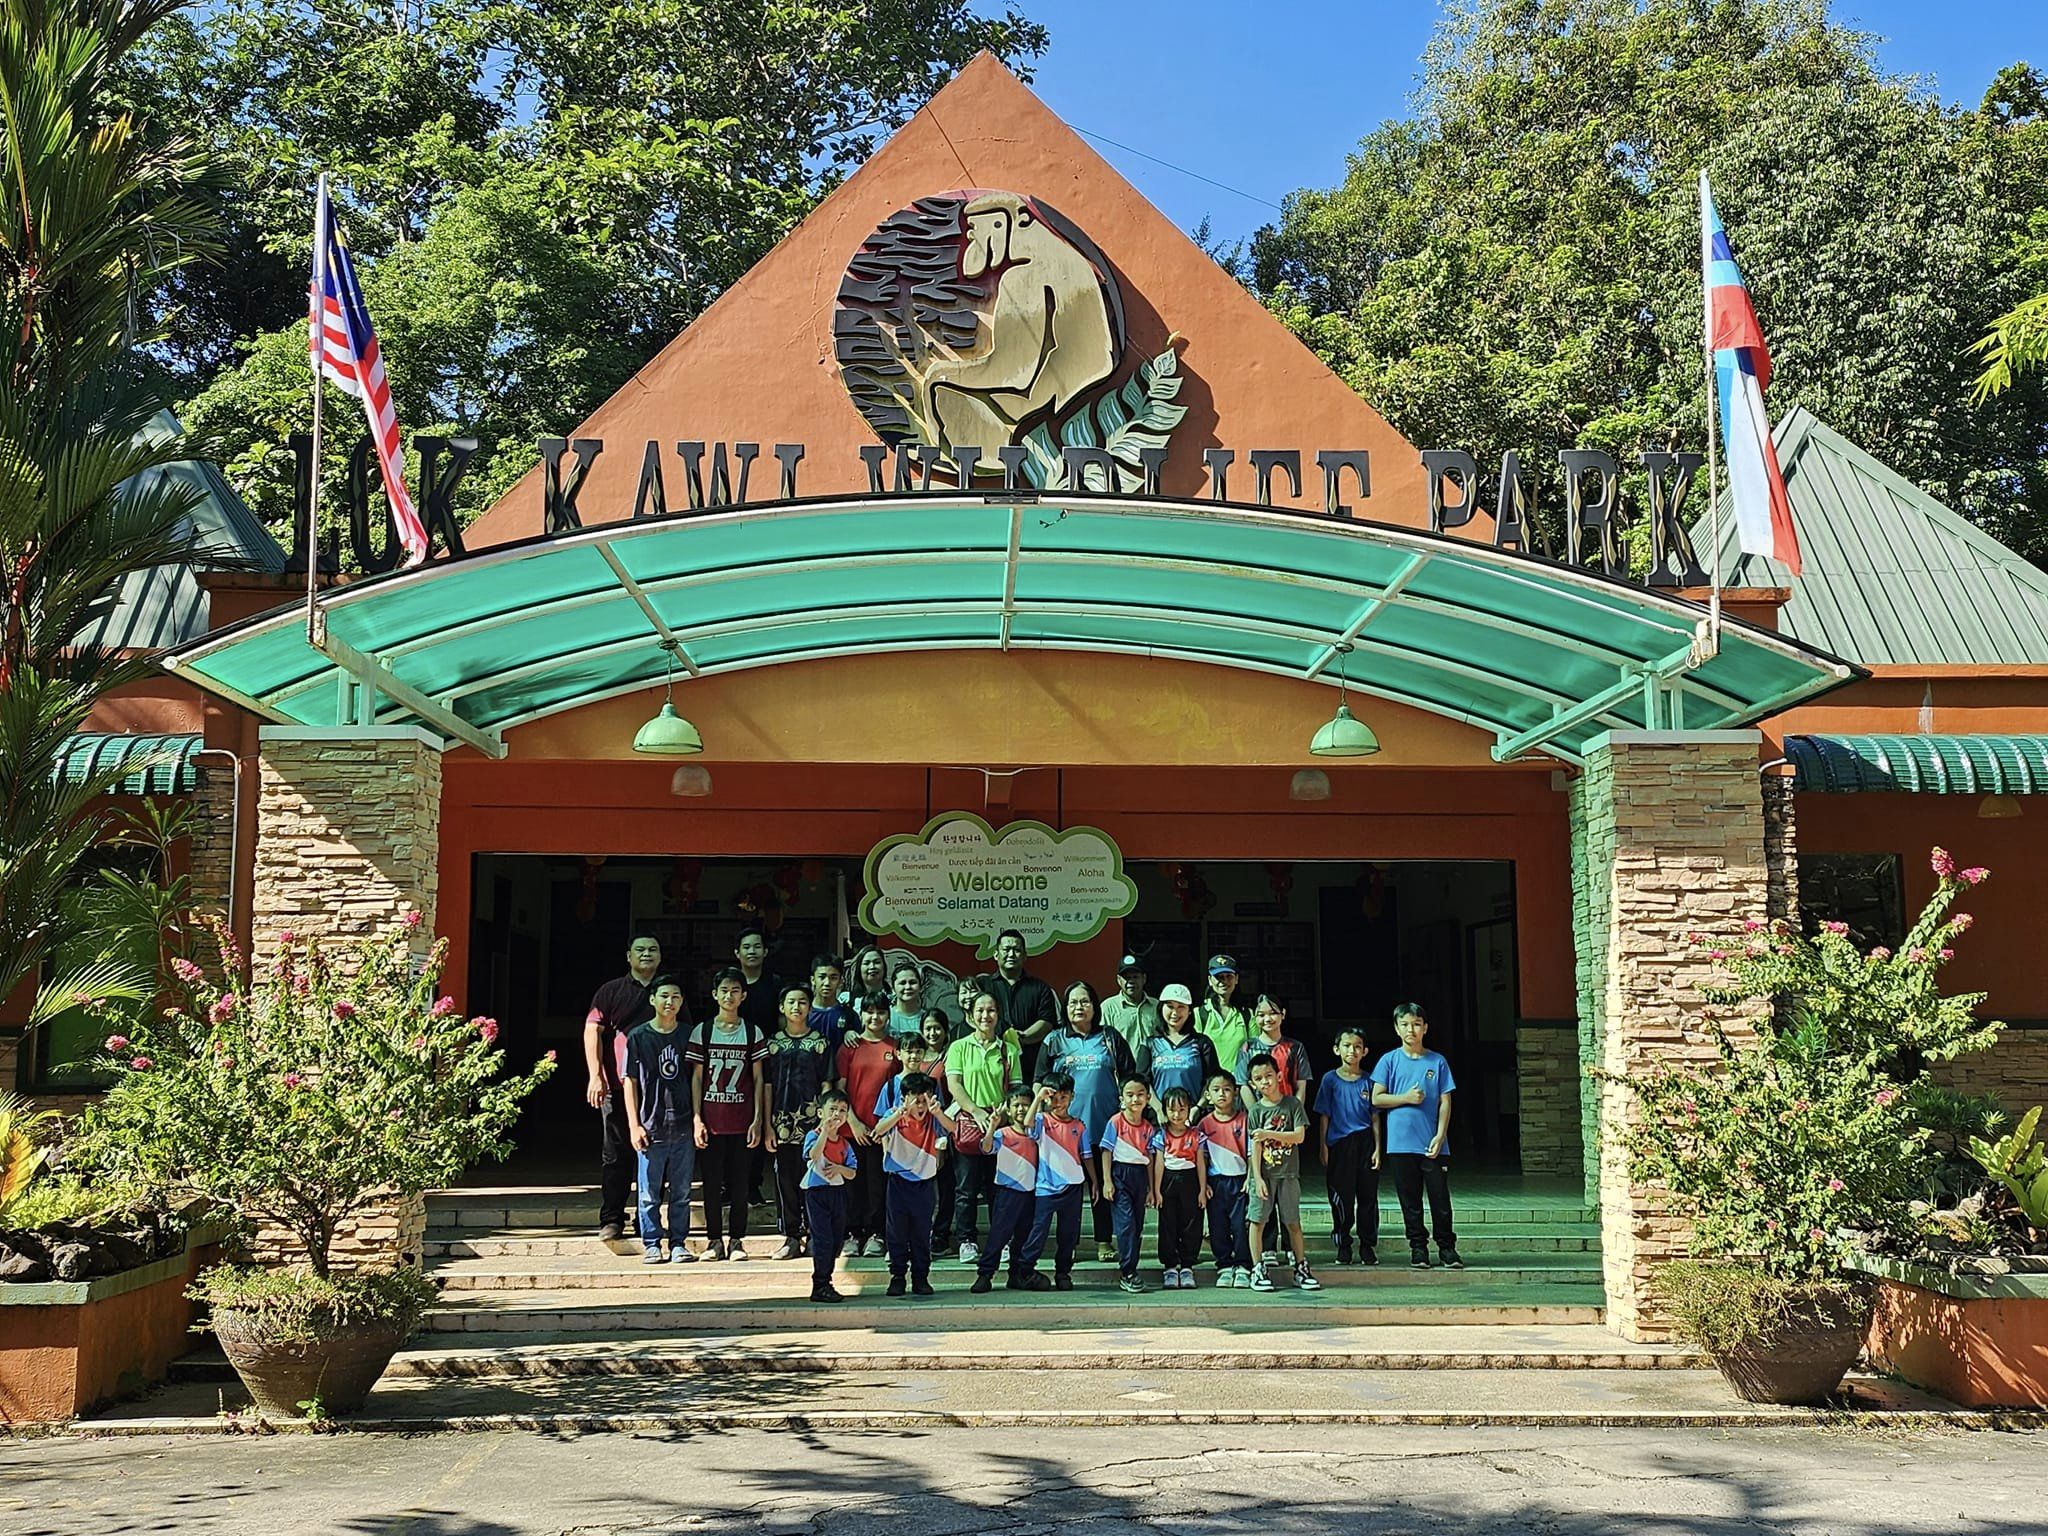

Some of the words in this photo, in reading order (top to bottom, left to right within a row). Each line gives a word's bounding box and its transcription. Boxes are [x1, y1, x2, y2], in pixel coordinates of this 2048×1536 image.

[285, 434, 480, 574] LOK
[1420, 450, 1712, 587] PARK
[1023, 864, 1062, 873] Bonvenon
[1077, 867, 1105, 878] Aloha
[949, 871, 1048, 892] Welcome
[937, 896, 995, 910] Selamat
[999, 896, 1049, 912] Datang
[960, 917, 995, 929] ようこそ
[1008, 914, 1045, 926] Witamy
[1000, 927, 1045, 935] Benidos
[708, 1058, 745, 1093] 77
[704, 1091, 745, 1103] EXTREME
